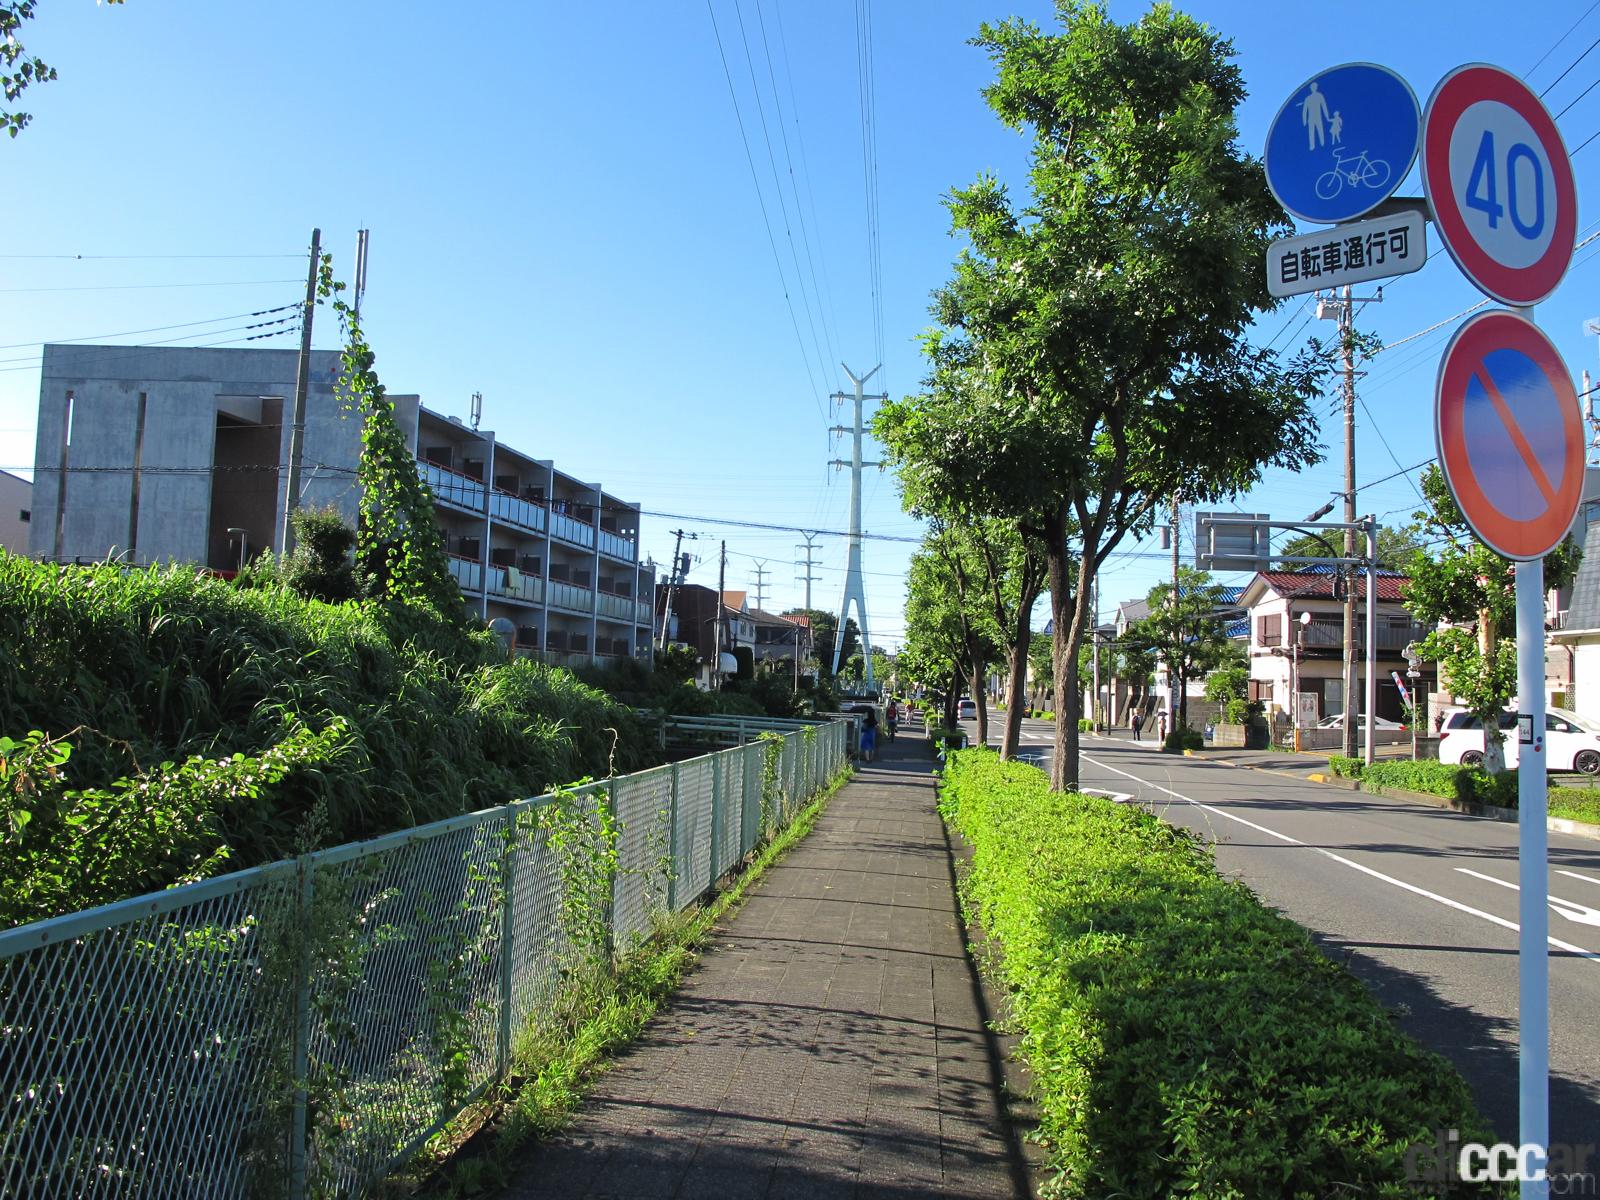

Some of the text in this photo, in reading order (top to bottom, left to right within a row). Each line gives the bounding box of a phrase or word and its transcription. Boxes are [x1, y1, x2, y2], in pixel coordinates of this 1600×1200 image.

[1465, 130, 1545, 240] 40
[1281, 225, 1410, 284] 自転車通行可
